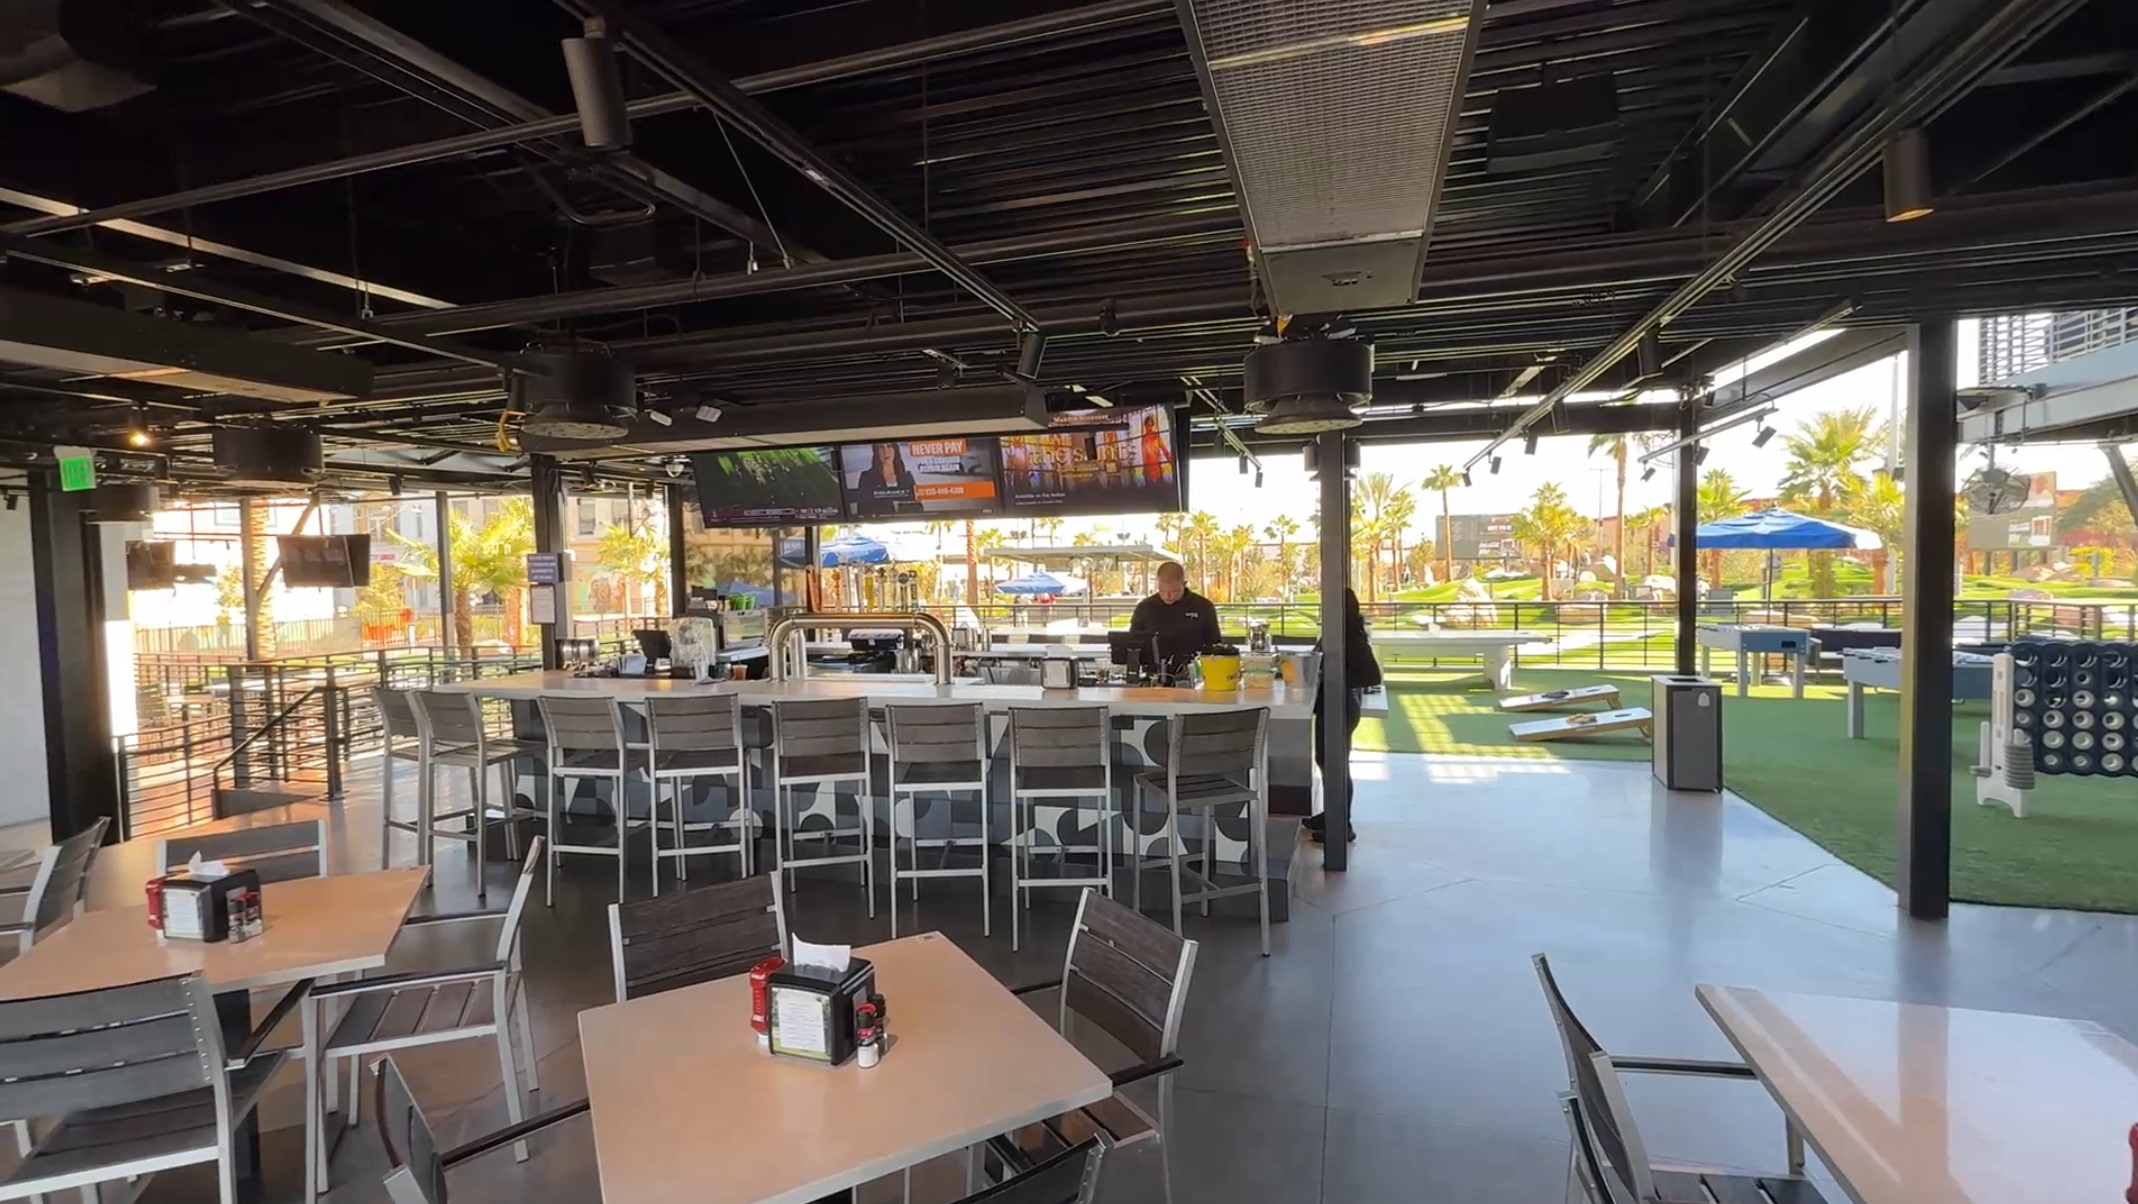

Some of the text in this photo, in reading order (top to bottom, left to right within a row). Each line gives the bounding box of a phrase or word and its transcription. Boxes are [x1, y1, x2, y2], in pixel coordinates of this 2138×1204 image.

[911, 441, 962, 456] NEVER PAY
[1073, 446, 1137, 463] snts
